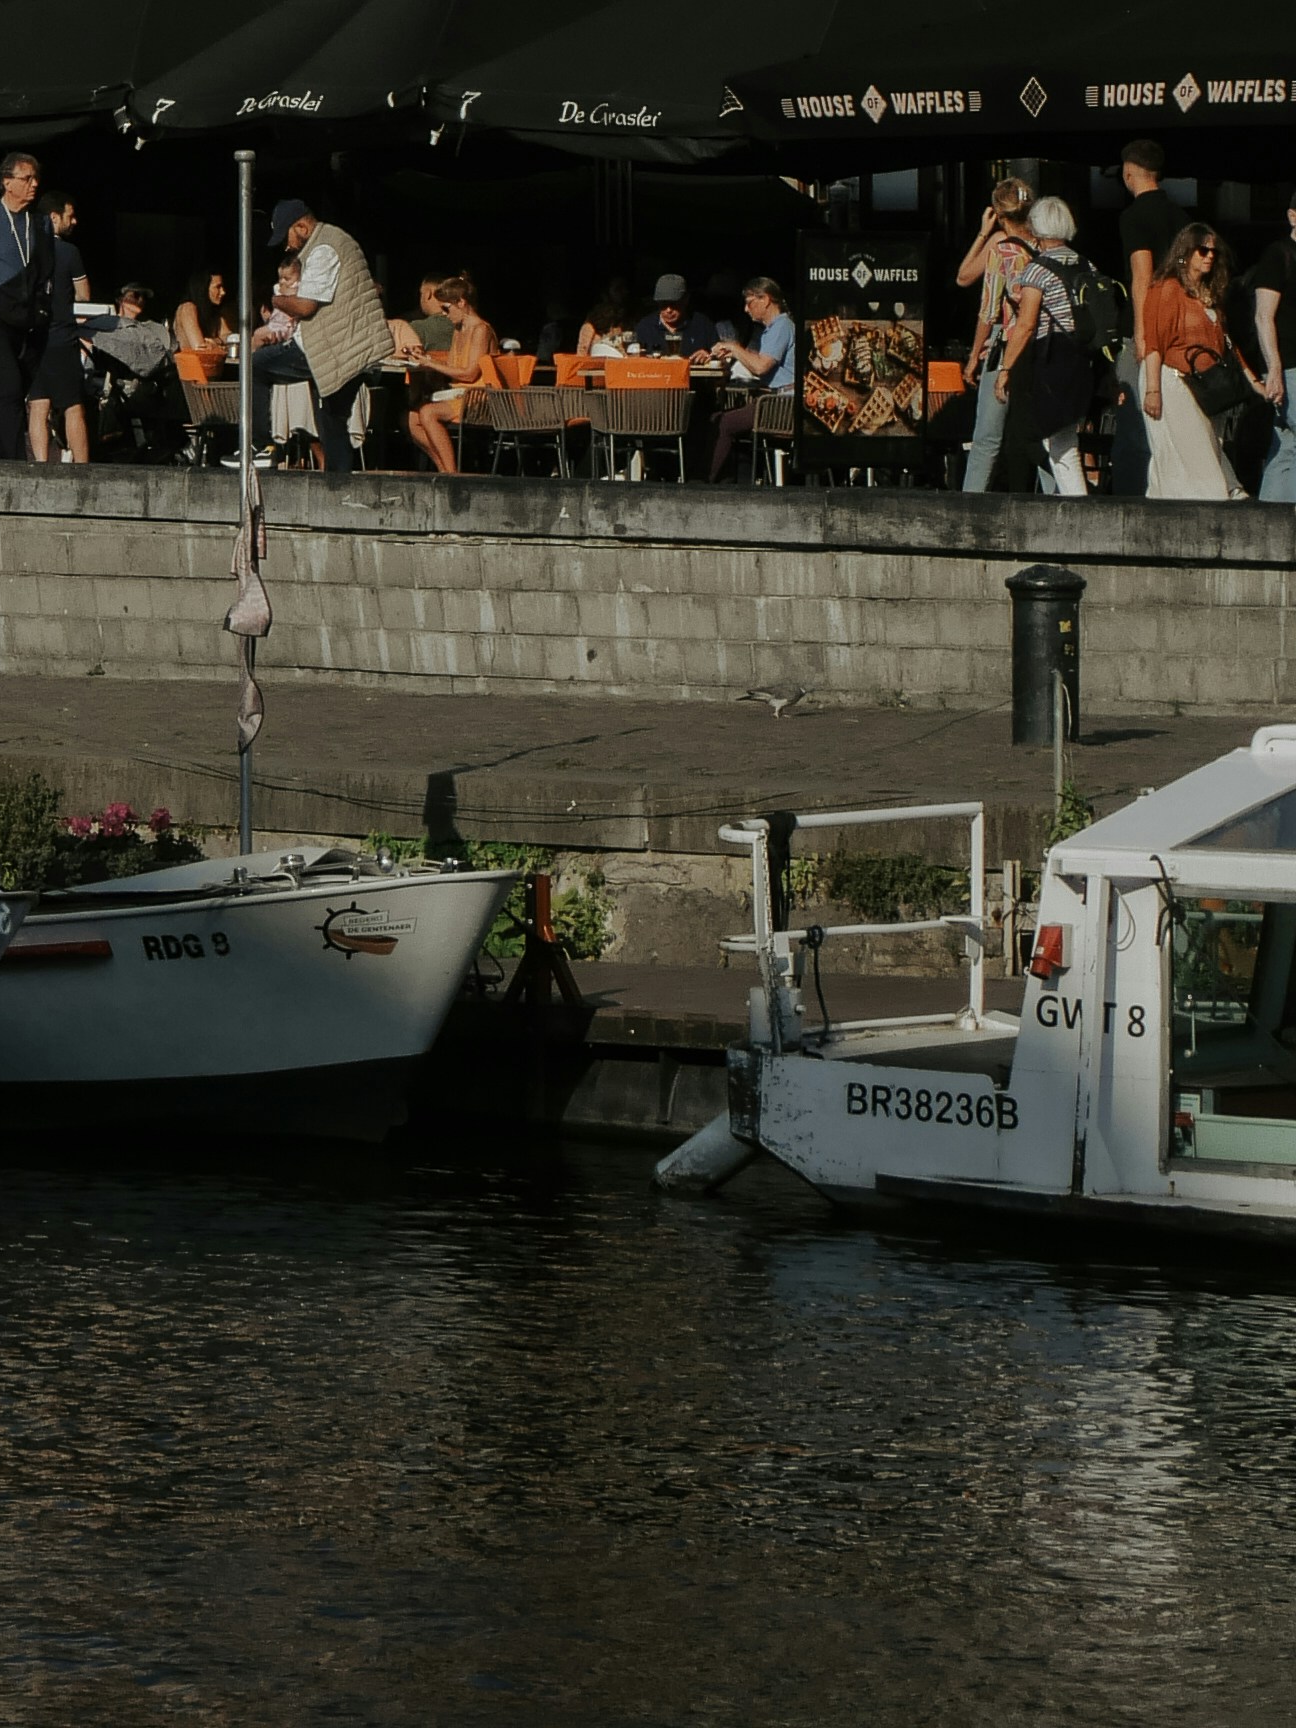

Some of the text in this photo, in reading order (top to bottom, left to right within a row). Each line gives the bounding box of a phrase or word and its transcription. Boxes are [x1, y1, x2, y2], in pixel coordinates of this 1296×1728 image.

[258, 90, 324, 112] Graslei
[796, 90, 965, 118] HOUSE OF WAFFLES
[1103, 79, 1286, 107] HOUSE OF WAFFLES
[558, 100, 662, 127] De Graslei
[809, 267, 918, 282] HOUSE OF WAFFLES
[347, 923, 412, 934] DE GENTENAER
[141, 933, 206, 961] RDG
[1127, 1005, 1146, 1038] 8
[846, 1082, 1019, 1131] BR38236B
